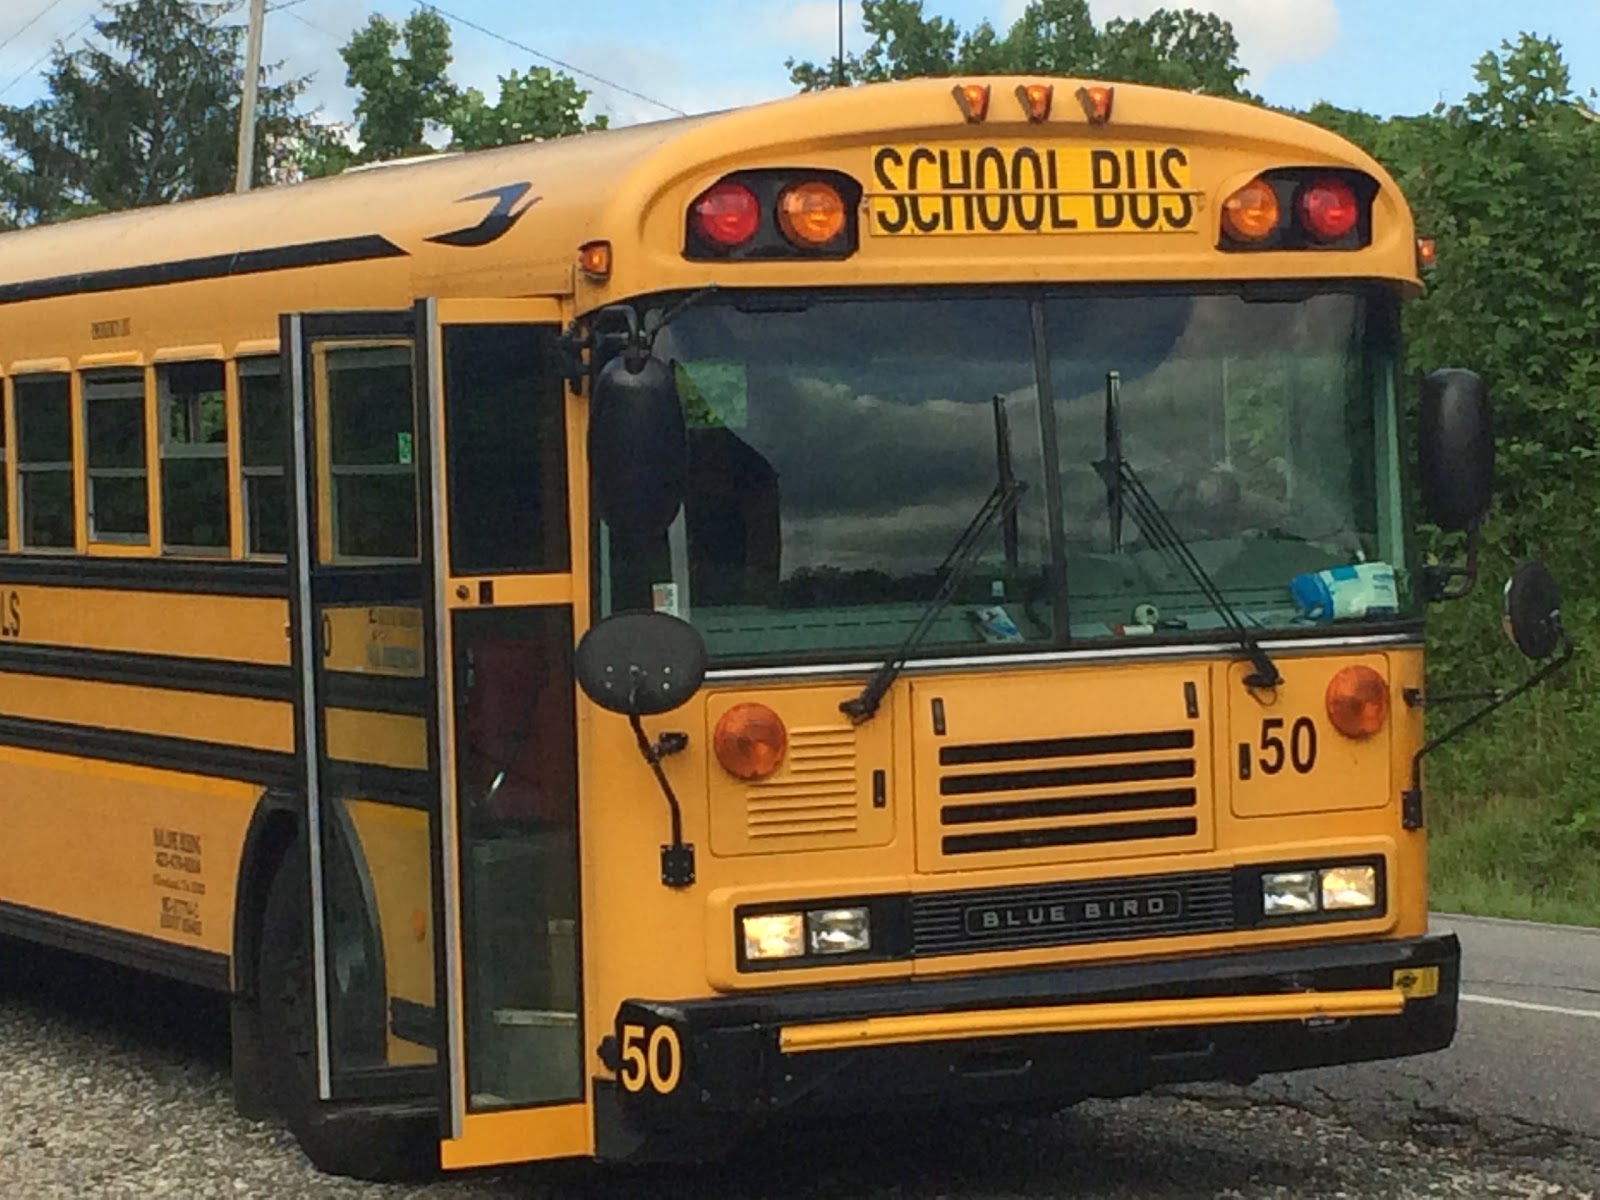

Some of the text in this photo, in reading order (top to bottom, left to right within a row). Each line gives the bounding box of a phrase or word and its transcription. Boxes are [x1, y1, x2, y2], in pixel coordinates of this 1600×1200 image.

[874, 147, 1192, 233] SCHOOL BUS
[1259, 716, 1317, 775] 50
[982, 897, 1164, 928] BLUE BIRD
[622, 1024, 681, 1094] 50
